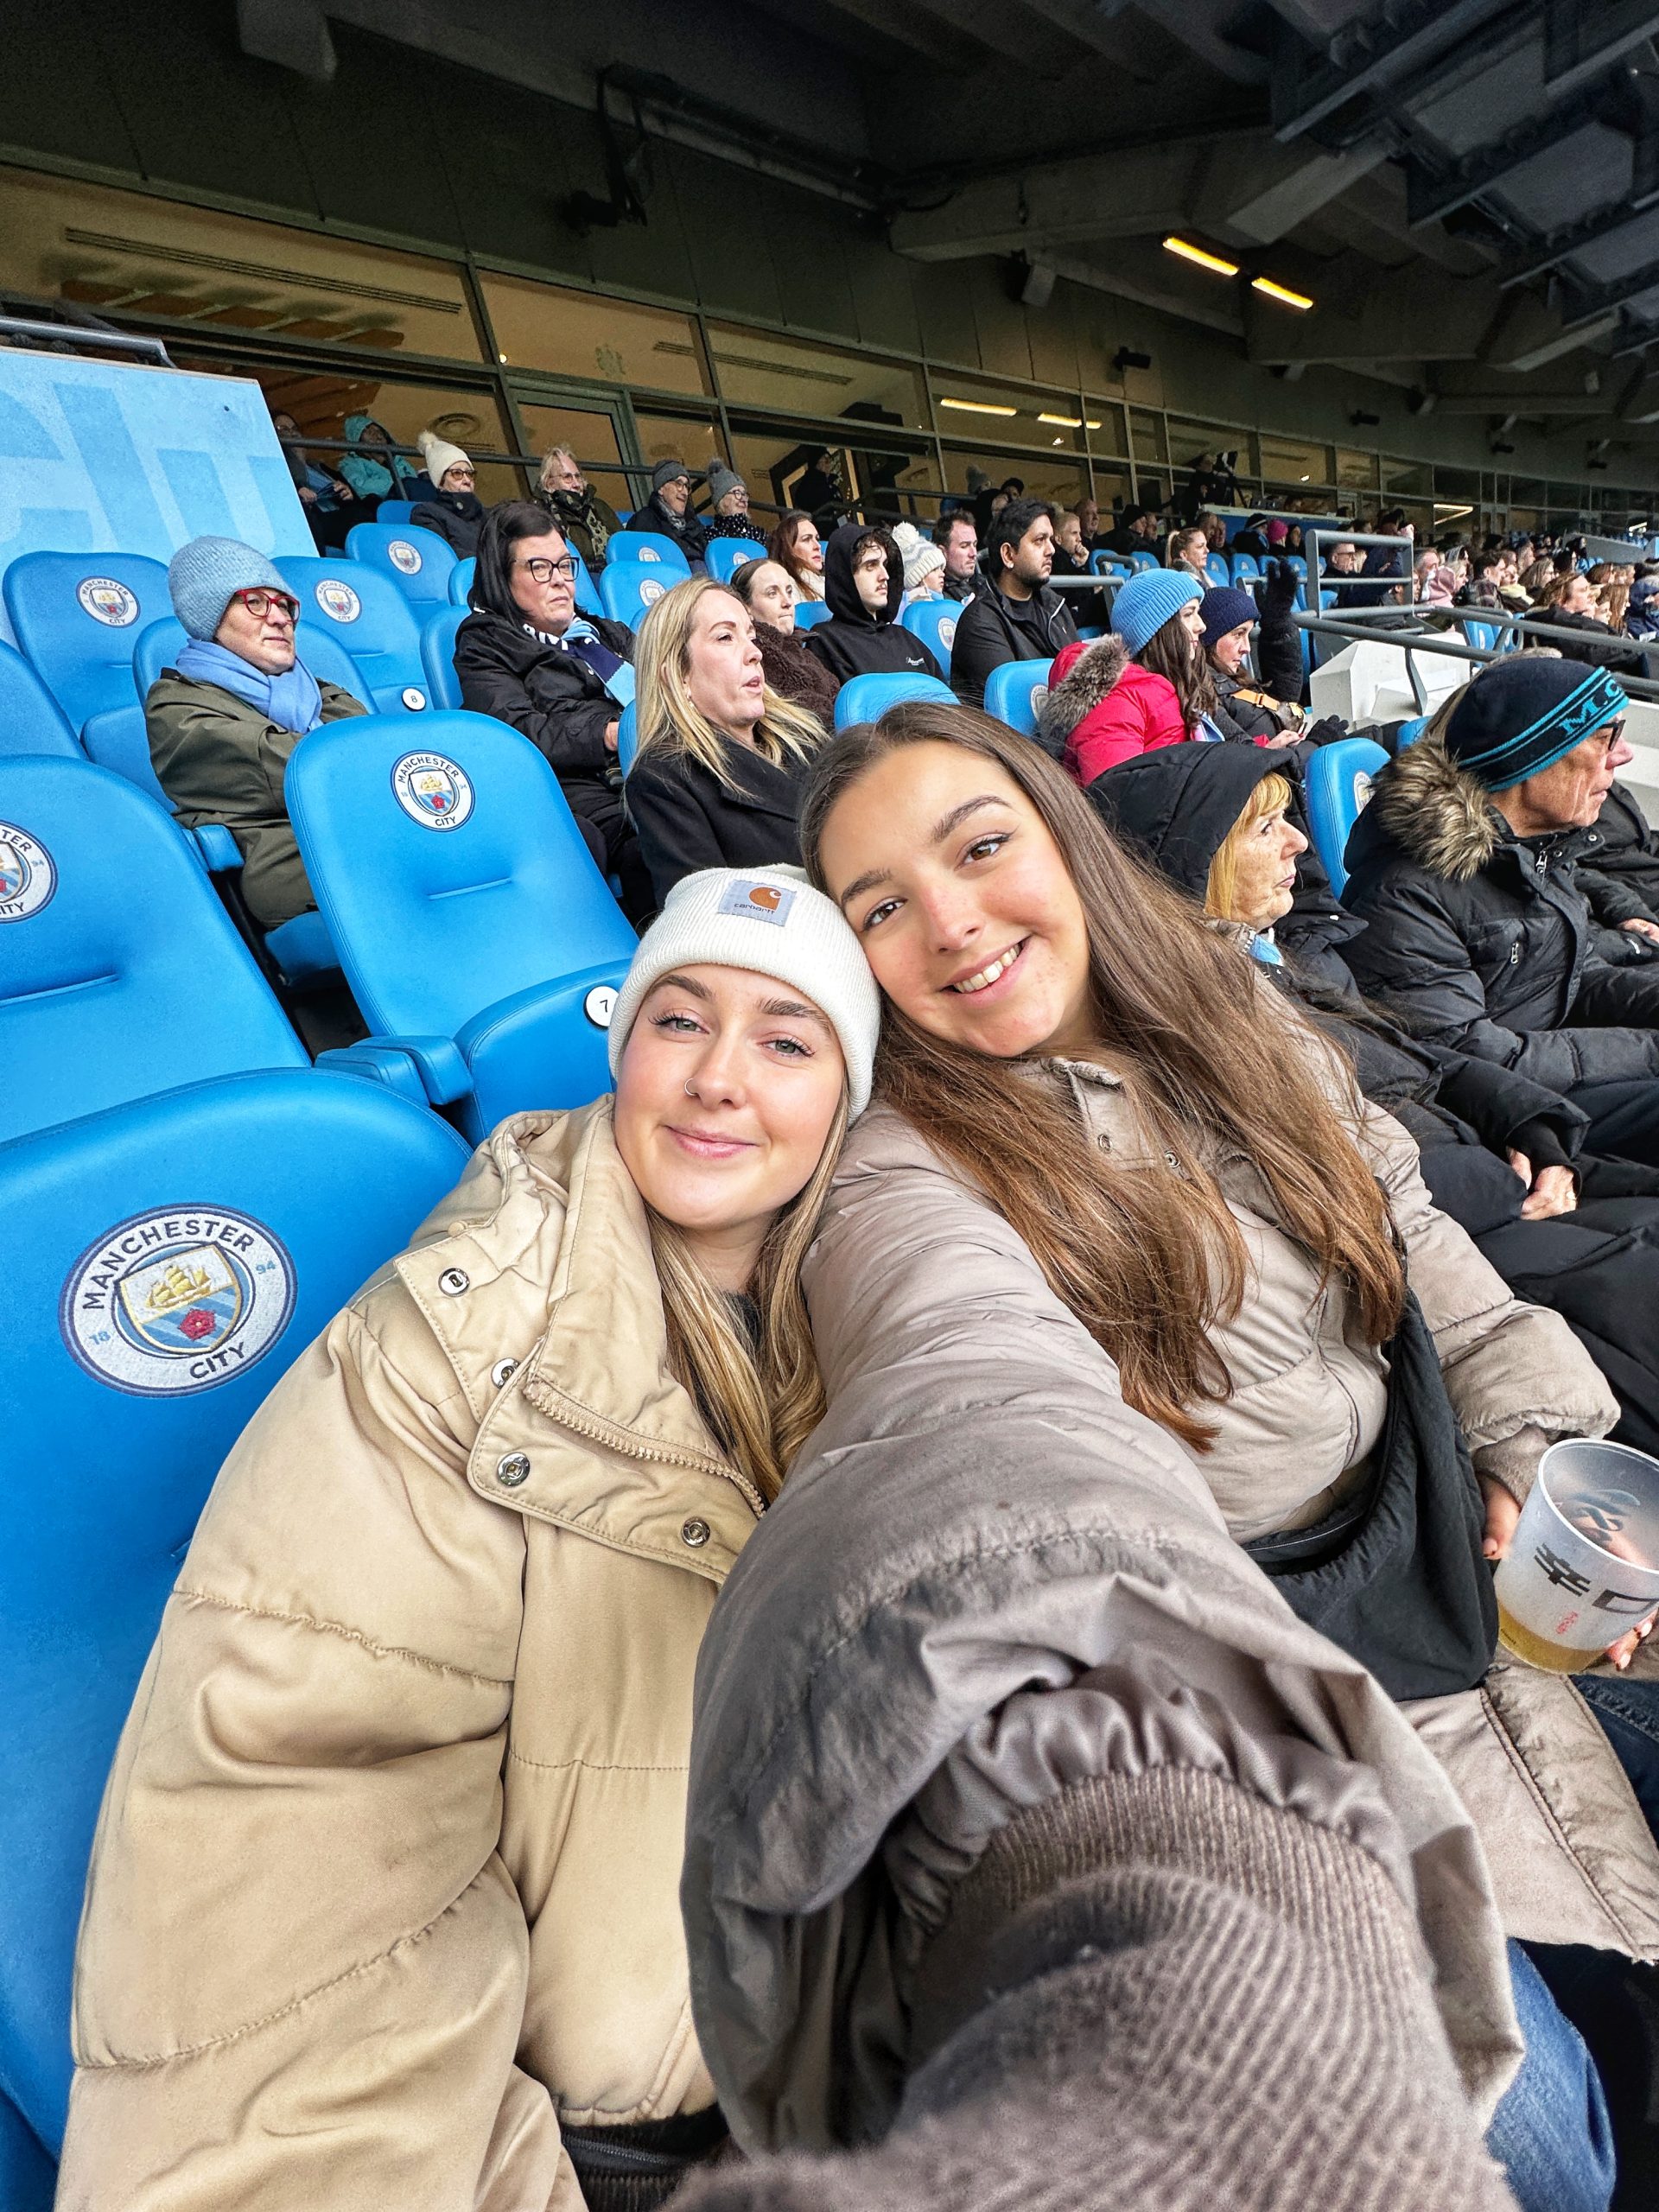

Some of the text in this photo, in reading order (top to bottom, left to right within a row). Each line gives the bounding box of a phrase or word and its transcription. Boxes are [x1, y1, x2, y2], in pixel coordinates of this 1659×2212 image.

[397, 756, 459, 784] MANCHESTER
[435, 816, 456, 827] CITY
[0, 901, 24, 914] ITY
[600, 999, 607, 1013] 7
[82, 1219, 255, 1309] MANCHESTER
[255, 1259, 276, 1274] 94
[89, 1330, 111, 1345] 18
[189, 1341, 245, 1379] CITY
